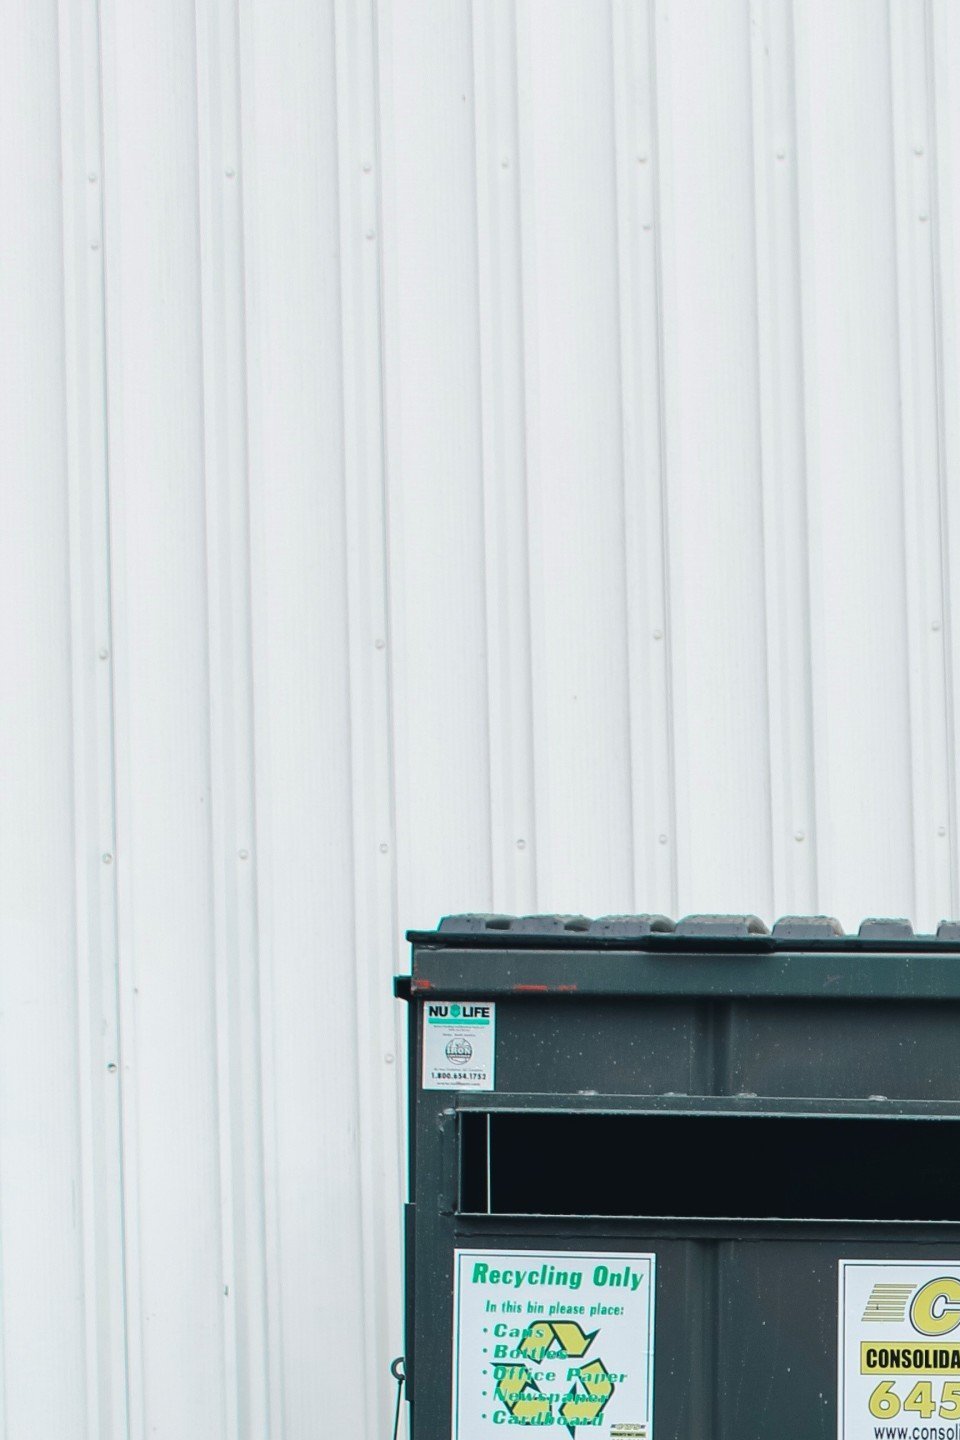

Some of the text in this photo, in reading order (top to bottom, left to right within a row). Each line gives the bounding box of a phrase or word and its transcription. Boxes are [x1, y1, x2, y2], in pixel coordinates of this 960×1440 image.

[429, 1006, 490, 1018] NU LIFE
[472, 1262, 645, 1291] Recycling Only
[485, 1300, 624, 1317] In this bin please place:
[493, 1322, 545, 1338] Cans
[493, 1344, 568, 1360] Bottles
[493, 1365, 628, 1384] Office Paper
[493, 1386, 609, 1405] Newspaper
[492, 1409, 605, 1426] Cardboard
